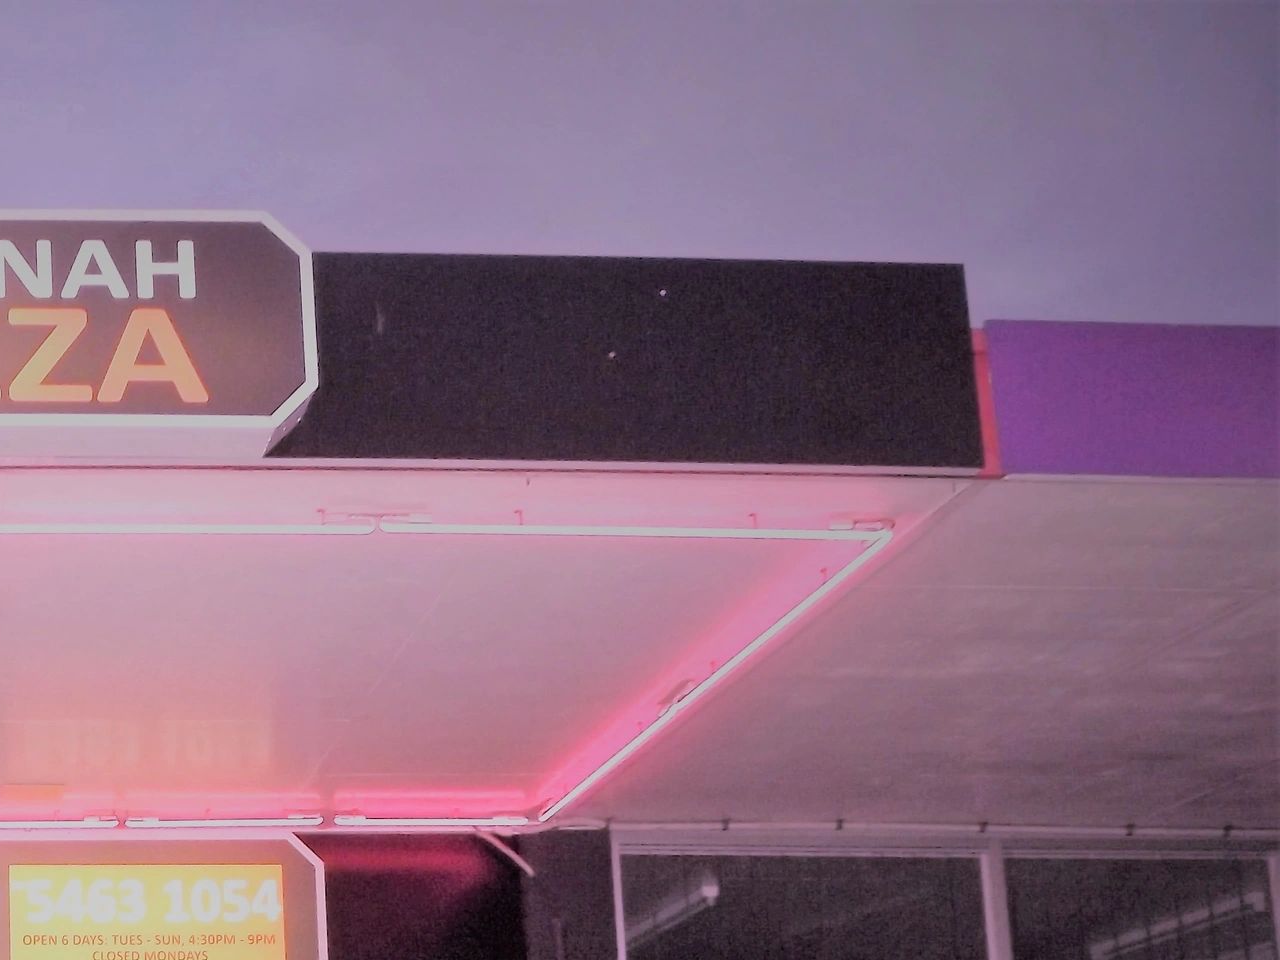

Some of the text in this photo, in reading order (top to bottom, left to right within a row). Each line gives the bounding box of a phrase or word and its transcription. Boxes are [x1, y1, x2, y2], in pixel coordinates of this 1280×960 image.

[24, 878, 281, 925] 5463 1054
[22, 934, 58, 946] OPEN
[61, 934, 70, 946] 6
[111, 934, 143, 946] TUES
[155, 934, 185, 948] SUN,
[188, 934, 237, 945] 4:30PM
[247, 934, 277, 945] 9PM
